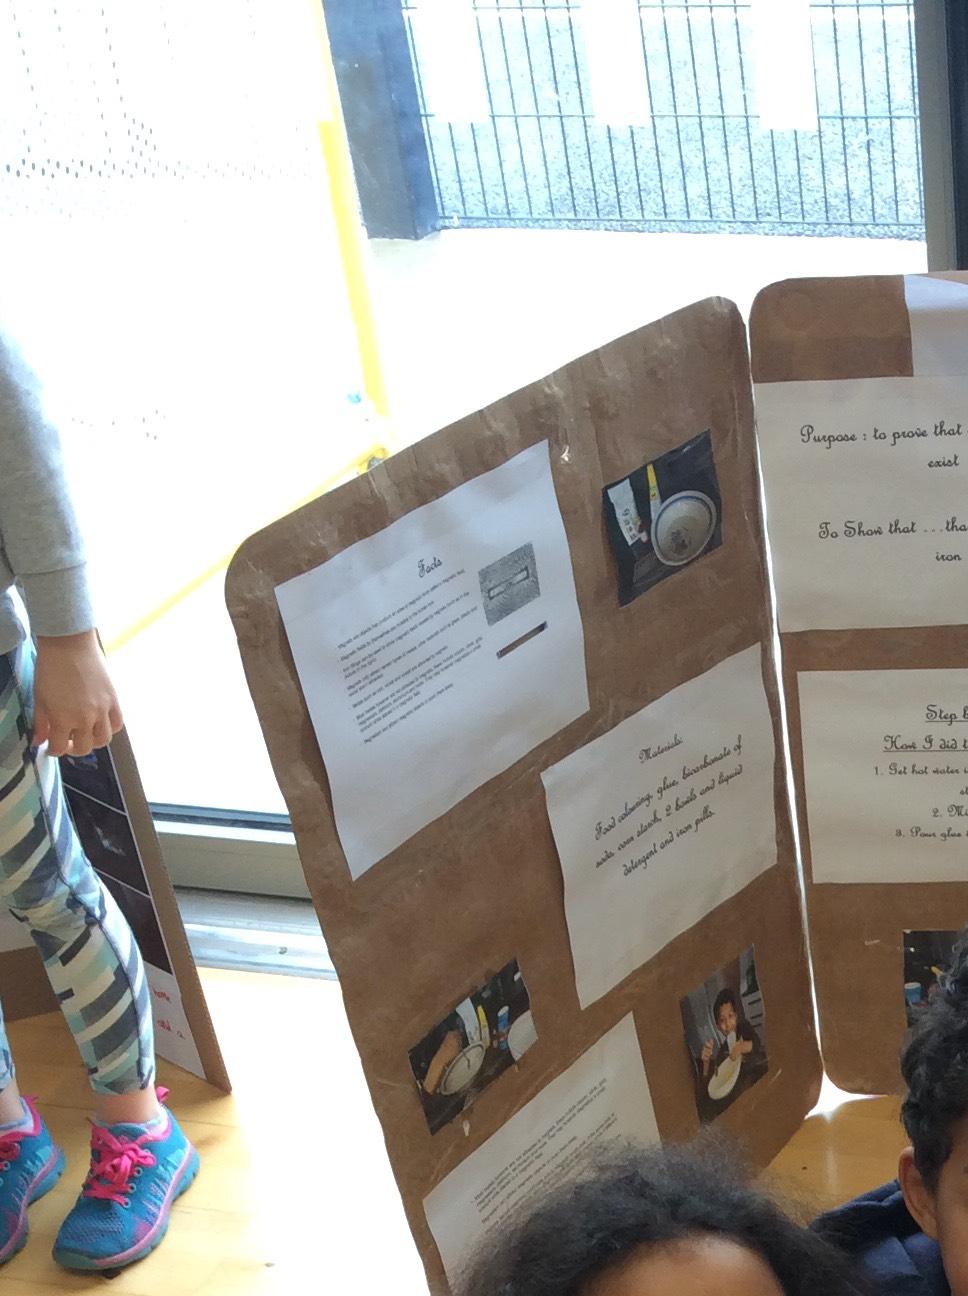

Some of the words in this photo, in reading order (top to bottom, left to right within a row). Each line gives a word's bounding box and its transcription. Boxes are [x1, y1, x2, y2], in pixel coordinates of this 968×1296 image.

[800, 424, 857, 449] Purpose
[873, 427, 887, 440] to
[891, 428, 928, 446] prove
[934, 421, 962, 437] that
[928, 454, 959, 469] exist
[818, 522, 839, 539] To
[843, 520, 883, 537] Show
[888, 519, 917, 534] that
[417, 556, 443, 578] Facts
[936, 551, 962, 563] iron
[926, 704, 957, 726] Step
[883, 735, 917, 751] How
[924, 734, 934, 750] I
[939, 738, 958, 750] did
[888, 762, 908, 775] Get
[911, 764, 928, 775] hot
[932, 765, 960, 775] water
[595, 816, 616, 840] Food
[682, 747, 731, 780] bicarbonate
[733, 734, 742, 756] of
[700, 778, 715, 796] and
[718, 763, 743, 785] liquid
[910, 826, 937, 838] Pour
[940, 827, 962, 841] glue
[622, 842, 658, 877] detergent
[660, 831, 675, 850] and
[676, 823, 692, 838] iron
